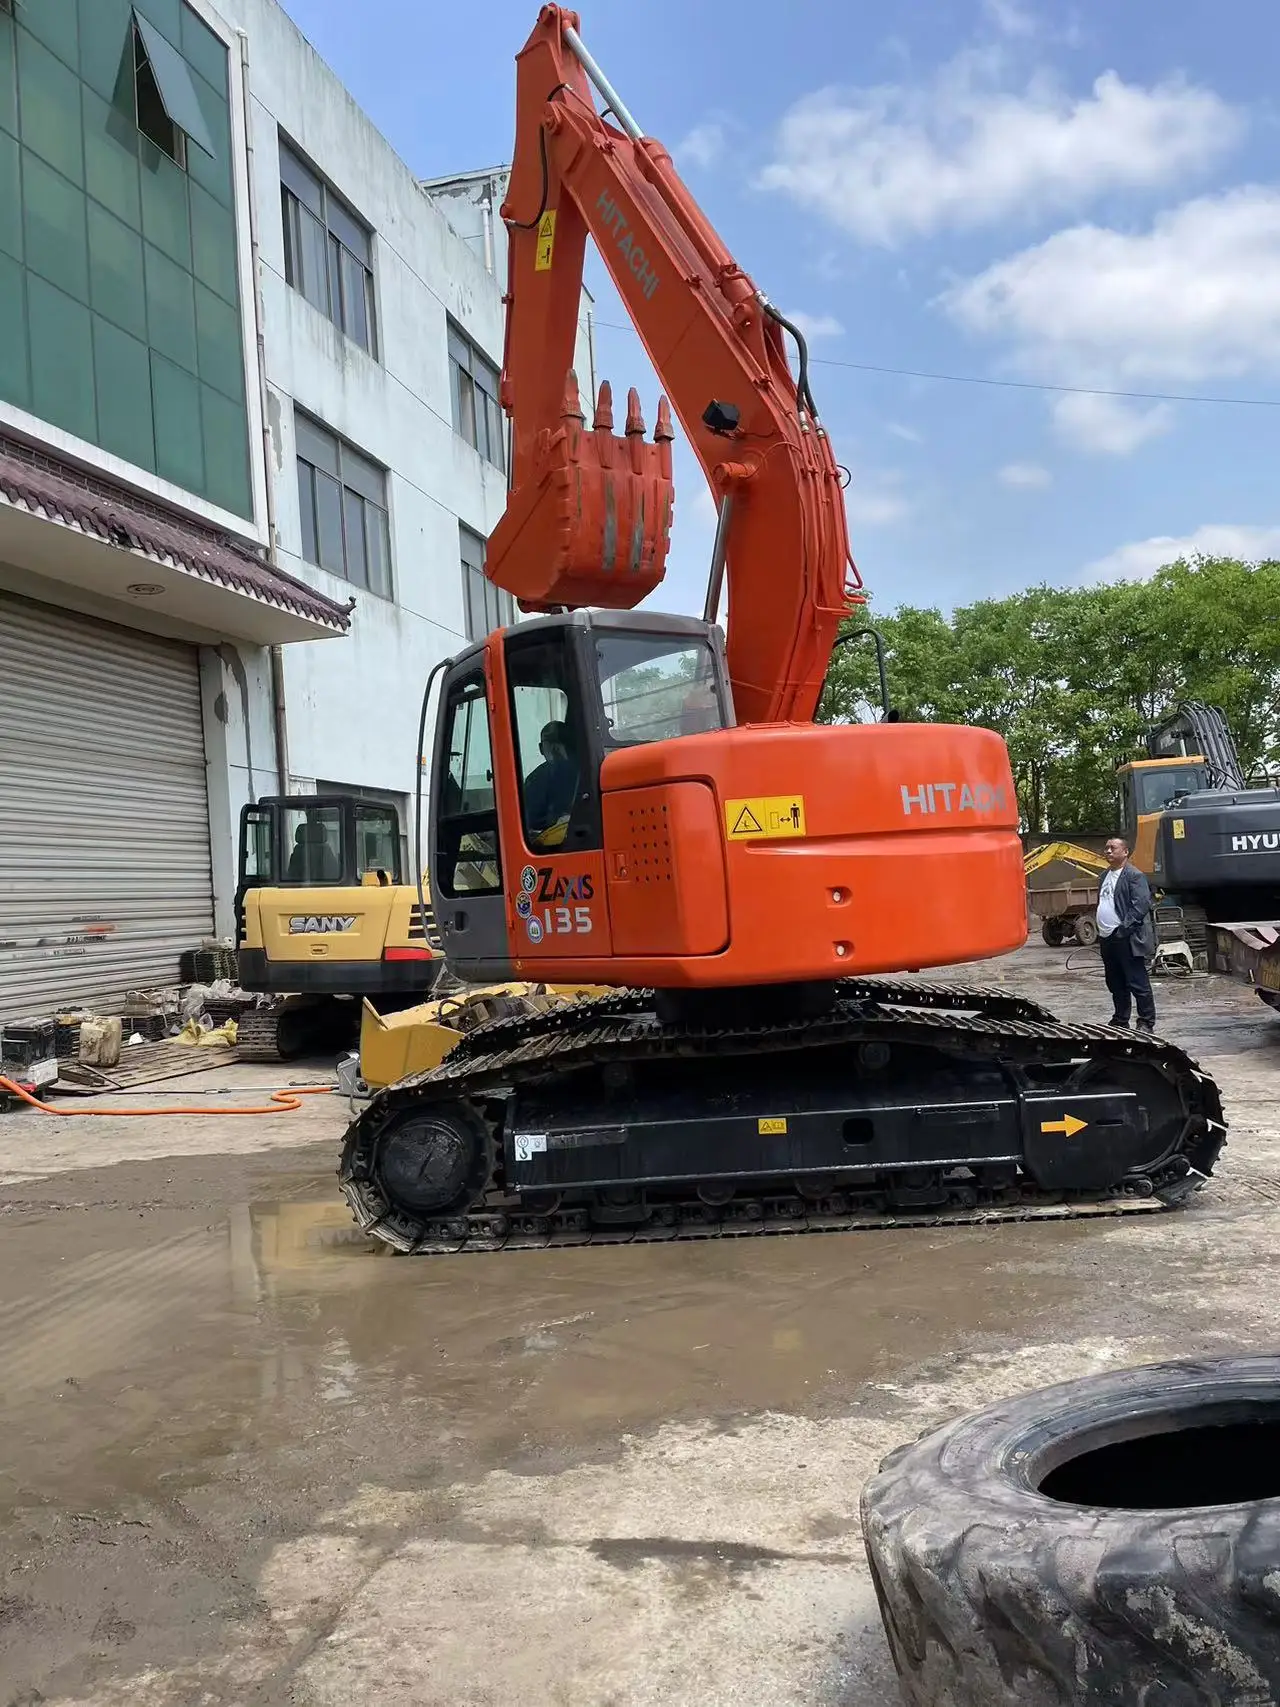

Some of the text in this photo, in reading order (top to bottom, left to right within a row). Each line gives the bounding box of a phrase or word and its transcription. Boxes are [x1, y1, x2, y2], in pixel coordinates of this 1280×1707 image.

[595, 187, 661, 301] HITACHI
[1231, 833, 1280, 851] HYU
[537, 867, 595, 904] ZAXIS
[288, 915, 357, 934] SANY
[543, 906, 593, 934] 135
